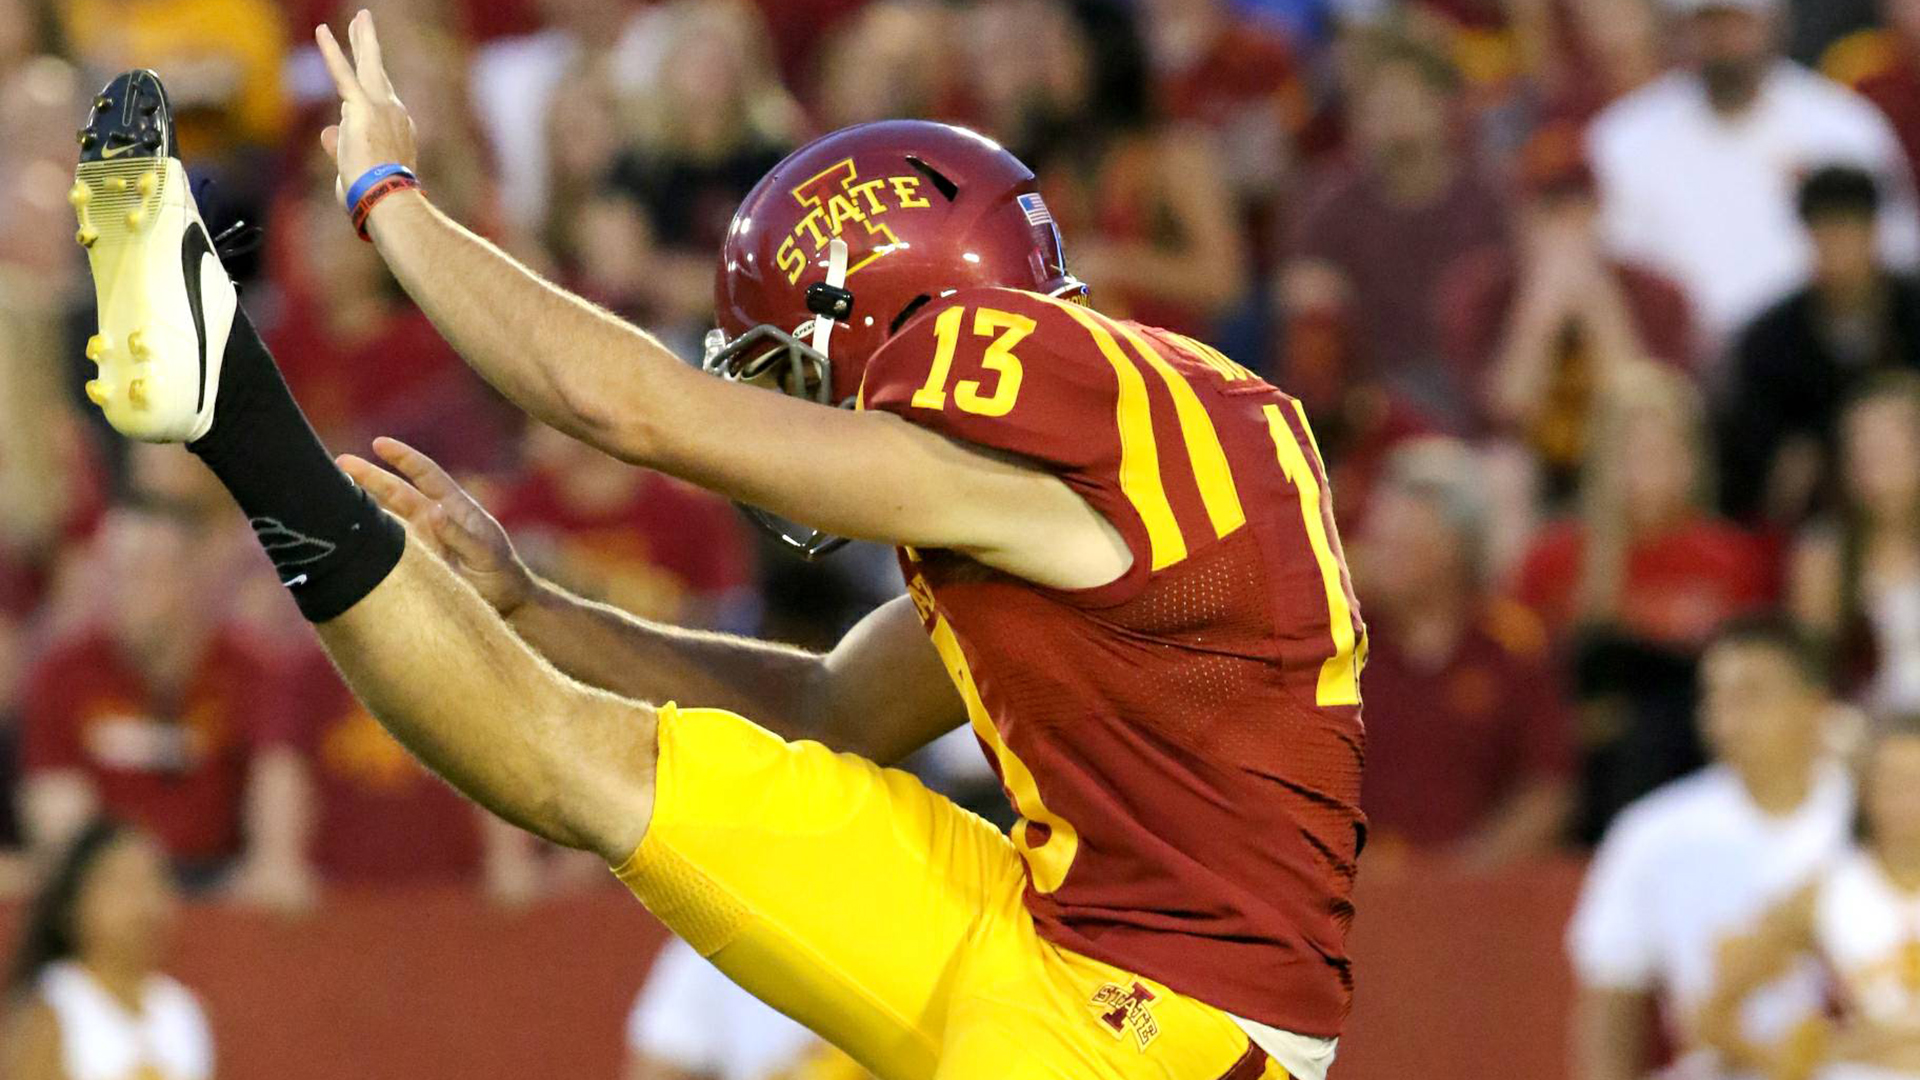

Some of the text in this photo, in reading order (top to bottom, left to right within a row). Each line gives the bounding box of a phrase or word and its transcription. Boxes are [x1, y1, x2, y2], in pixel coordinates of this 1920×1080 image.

[776, 176, 931, 286] STATE
[911, 306, 1037, 417] 13
[1091, 984, 1158, 1045] STATE
